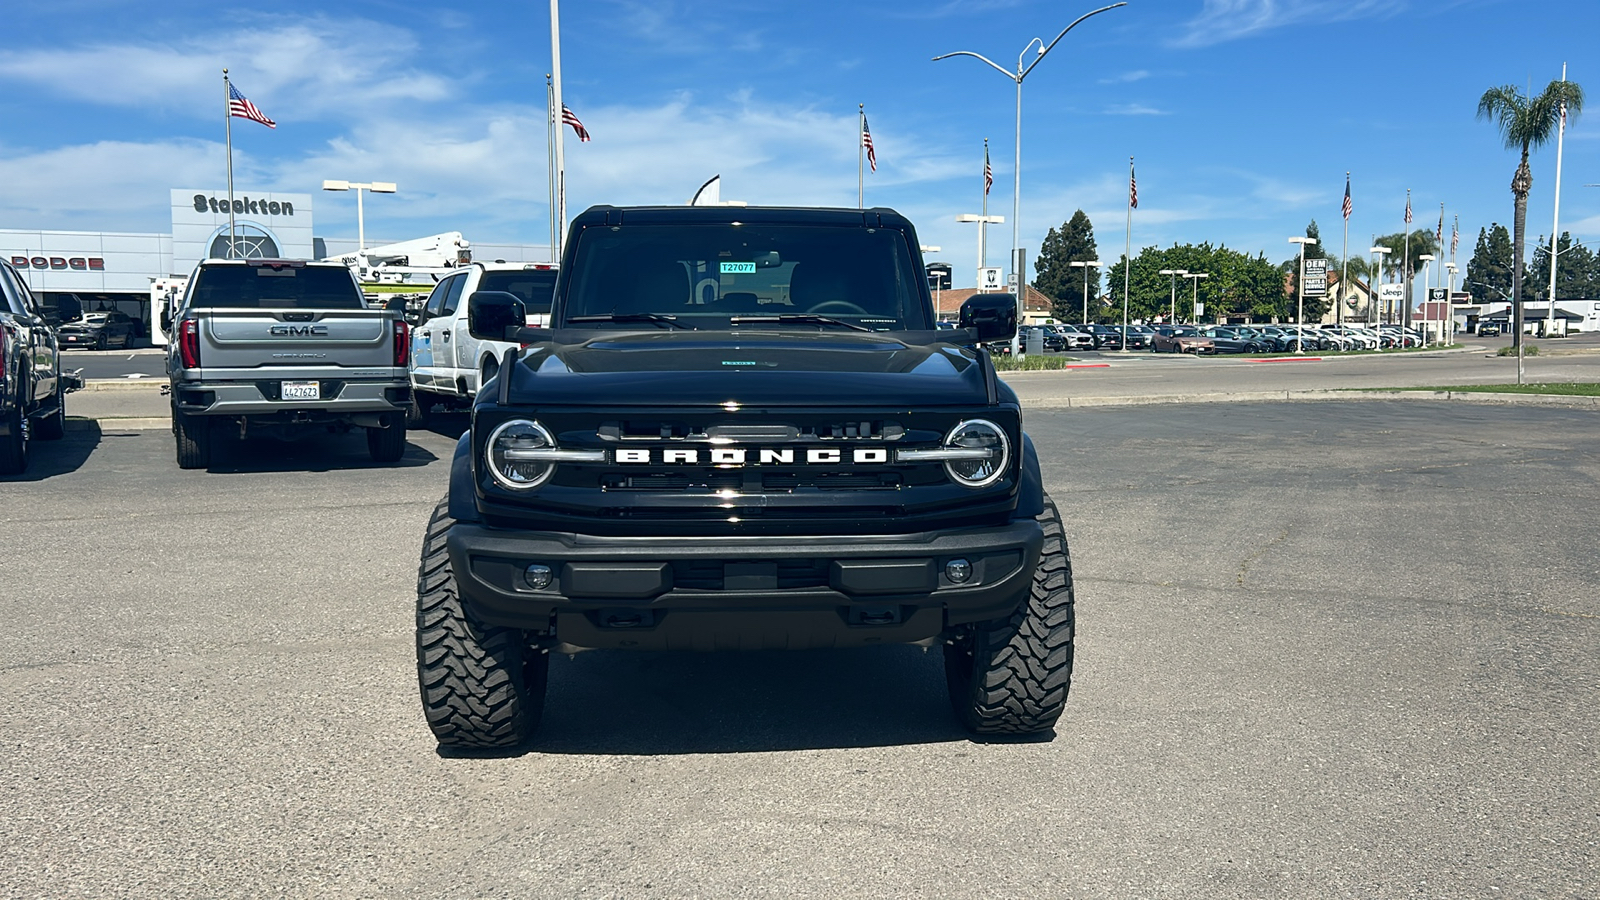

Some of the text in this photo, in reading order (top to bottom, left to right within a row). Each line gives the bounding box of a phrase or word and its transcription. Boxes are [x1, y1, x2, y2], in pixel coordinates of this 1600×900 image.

[193, 194, 294, 216] Stockton
[11, 256, 105, 271] DODGE
[721, 263, 754, 272] T27077
[1306, 260, 1326, 268] OEM
[270, 325, 328, 337] GMC
[615, 448, 888, 464] BRONCO
